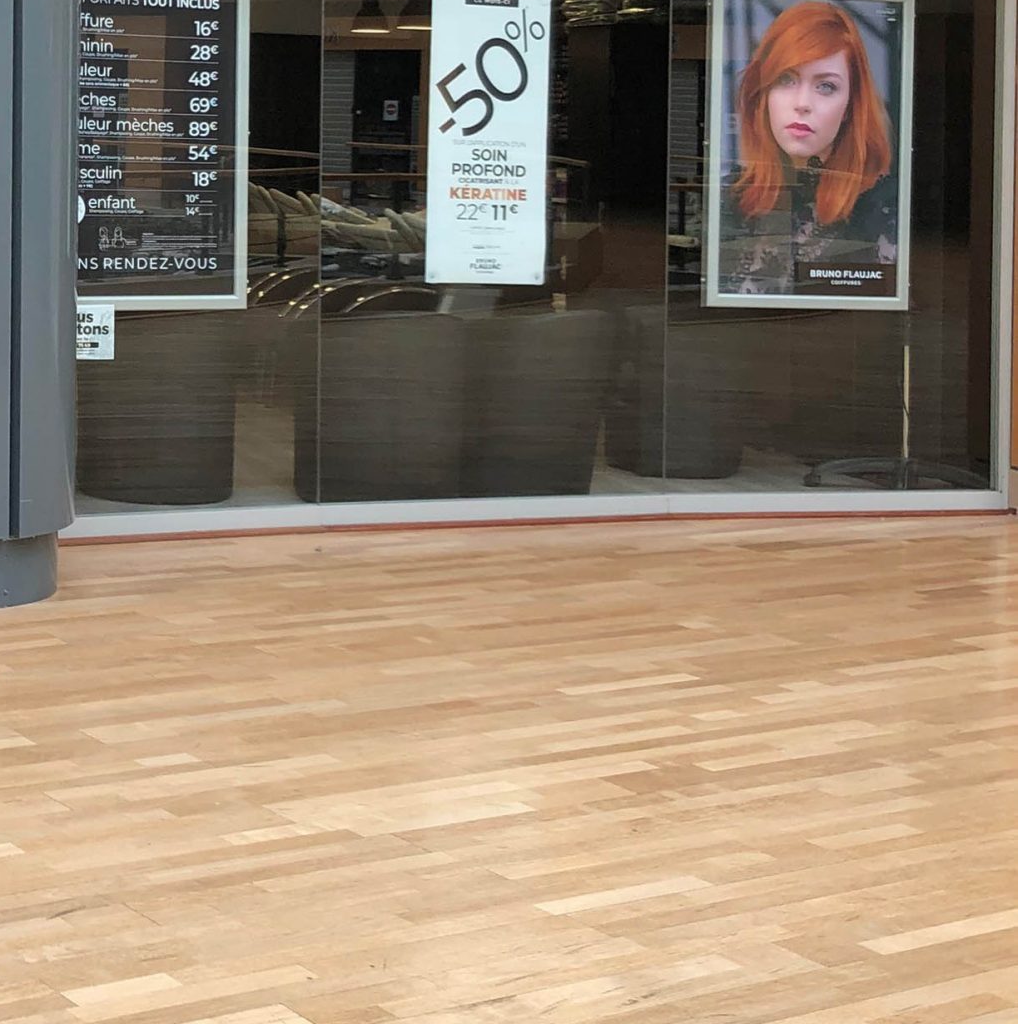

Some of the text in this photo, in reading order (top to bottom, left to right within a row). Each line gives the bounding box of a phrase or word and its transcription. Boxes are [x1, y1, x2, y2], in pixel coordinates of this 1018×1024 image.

[194, 21, 220, 36] 16€
[190, 45, 219, 61] 28€
[188, 71, 219, 87] 48€
[436, 8, 545, 137] -50%
[79, 92, 117, 107] ches
[189, 97, 218, 113] 69€
[116, 118, 174, 133] mèches
[189, 121, 218, 137] 89€
[188, 145, 218, 161] 54€
[471, 148, 508, 162] SOIN
[80, 165, 218, 187] sculin 18€
[451, 163, 527, 178] PROFOND
[449, 184, 527, 201] KÉRATINE
[88, 195, 136, 209] enfant
[456, 203, 519, 221] 22€ 11€
[77, 257, 218, 270] NS RENDEZ-VOUS
[810, 269, 883, 279] BRUNO FLAUJAC
